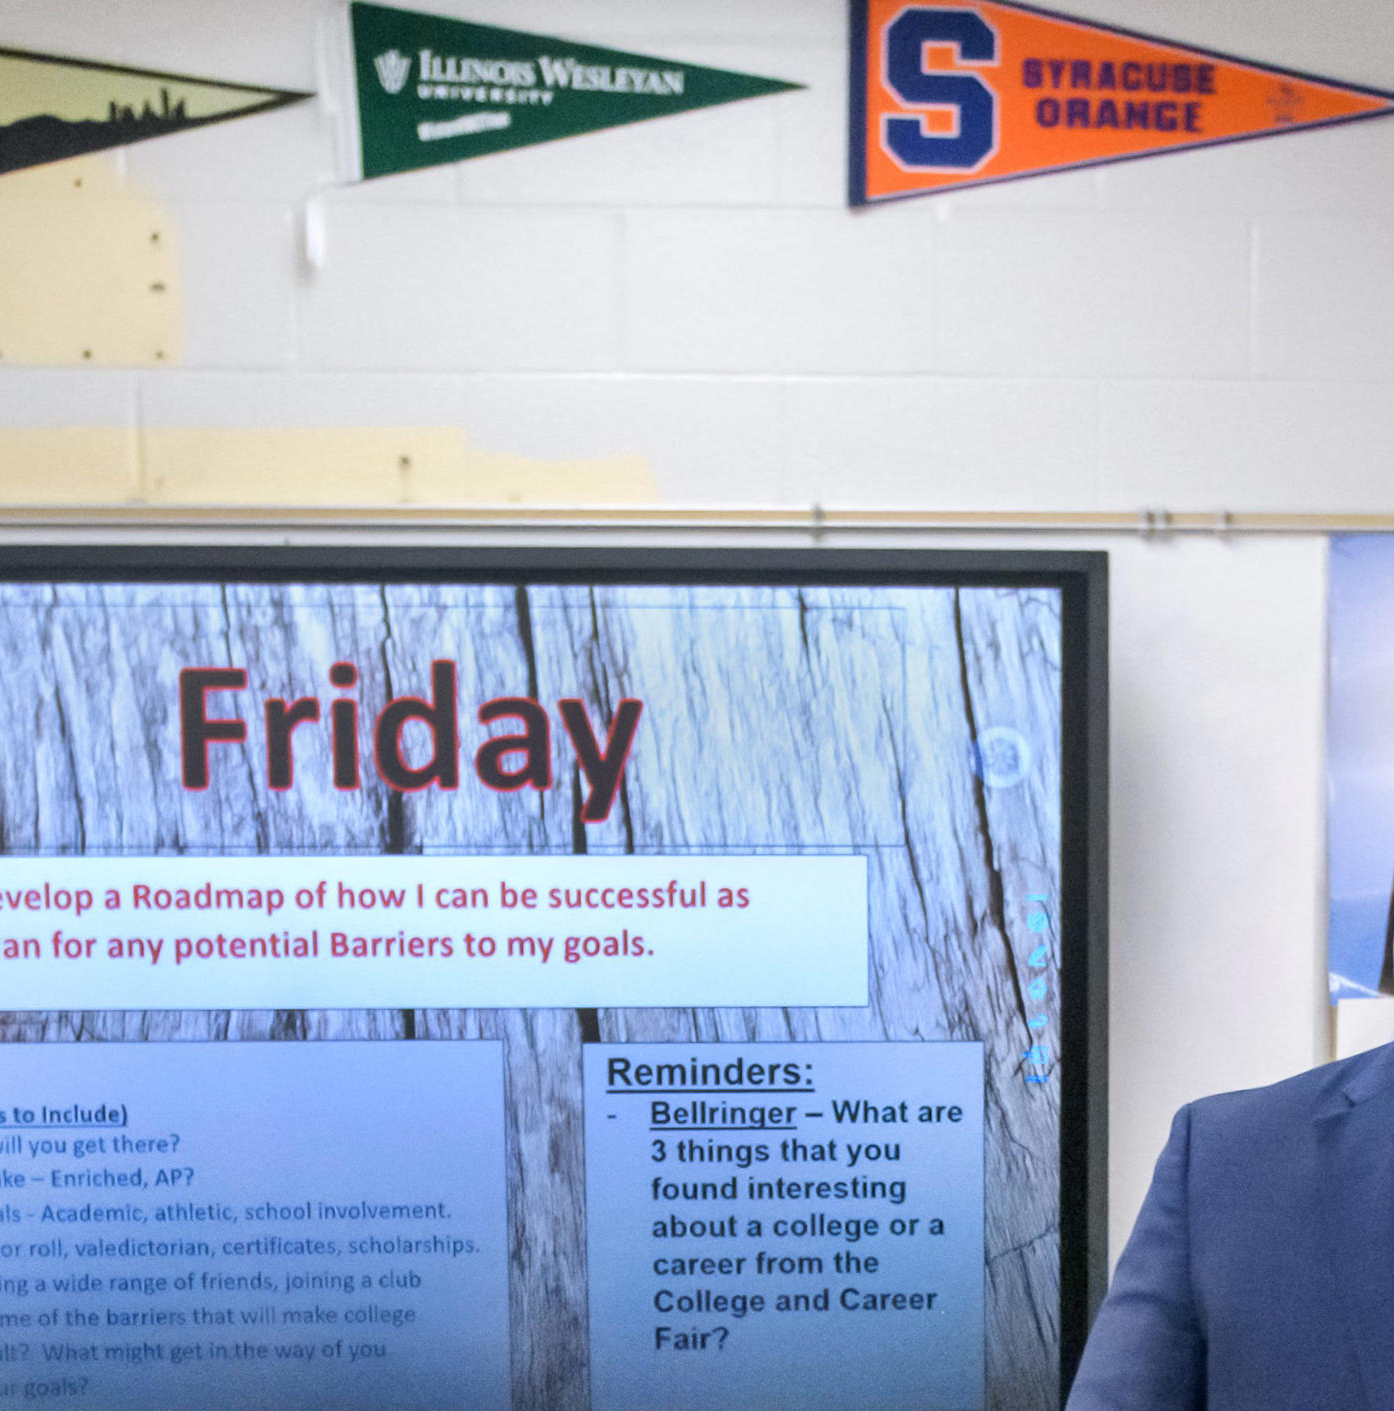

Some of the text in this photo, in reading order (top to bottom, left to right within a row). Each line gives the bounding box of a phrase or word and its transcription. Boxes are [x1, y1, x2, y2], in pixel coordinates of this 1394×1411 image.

[1022, 57, 1217, 94] SYRACUSE
[417, 83, 553, 106] UNIVERSITY
[880, 6, 1000, 174] S
[1035, 97, 1202, 133] ORANGE
[177, 659, 644, 823] Friday
[104, 889, 121, 908] a
[132, 883, 284, 915] Roadmap
[295, 882, 326, 908] of
[338, 883, 404, 908] how
[417, 884, 423, 908] I
[435, 886, 489, 908] can
[501, 882, 538, 908] be
[548, 880, 706, 908] successful
[718, 886, 750, 908] as
[53, 931, 96, 958] for
[108, 937, 161, 965] any
[175, 931, 318, 965] potential
[330, 932, 454, 957] Barriers
[465, 935, 496, 957] to
[507, 937, 555, 964] my
[564, 929, 655, 964] goals.
[607, 1057, 813, 1087] Reminders:
[13, 1108, 35, 1124] to
[43, 1105, 128, 1126] Include)
[650, 1099, 963, 1127] Bellringer What are
[29, 1139, 67, 1159] you
[73, 1137, 106, 1158] get
[112, 1133, 180, 1154] there?
[651, 1139, 900, 1168] 3 things that you
[50, 1169, 149, 1190] Enriched,
[155, 1168, 194, 1187] AP?
[652, 1176, 906, 1204] found interesting
[41, 1204, 148, 1223] Academic,
[155, 1202, 238, 1223] athletic,
[245, 1201, 312, 1221] school
[318, 1200, 451, 1220] involvement.
[652, 1213, 944, 1242] about a college or a
[28, 1239, 68, 1259] roll,
[76, 1238, 215, 1257] valedictorian,
[222, 1237, 342, 1257] certificates,
[348, 1236, 480, 1257] scholarships.
[653, 1251, 879, 1275] career from the
[654, 1288, 938, 1318] College and Career
[654, 1326, 730, 1350] Fair?
